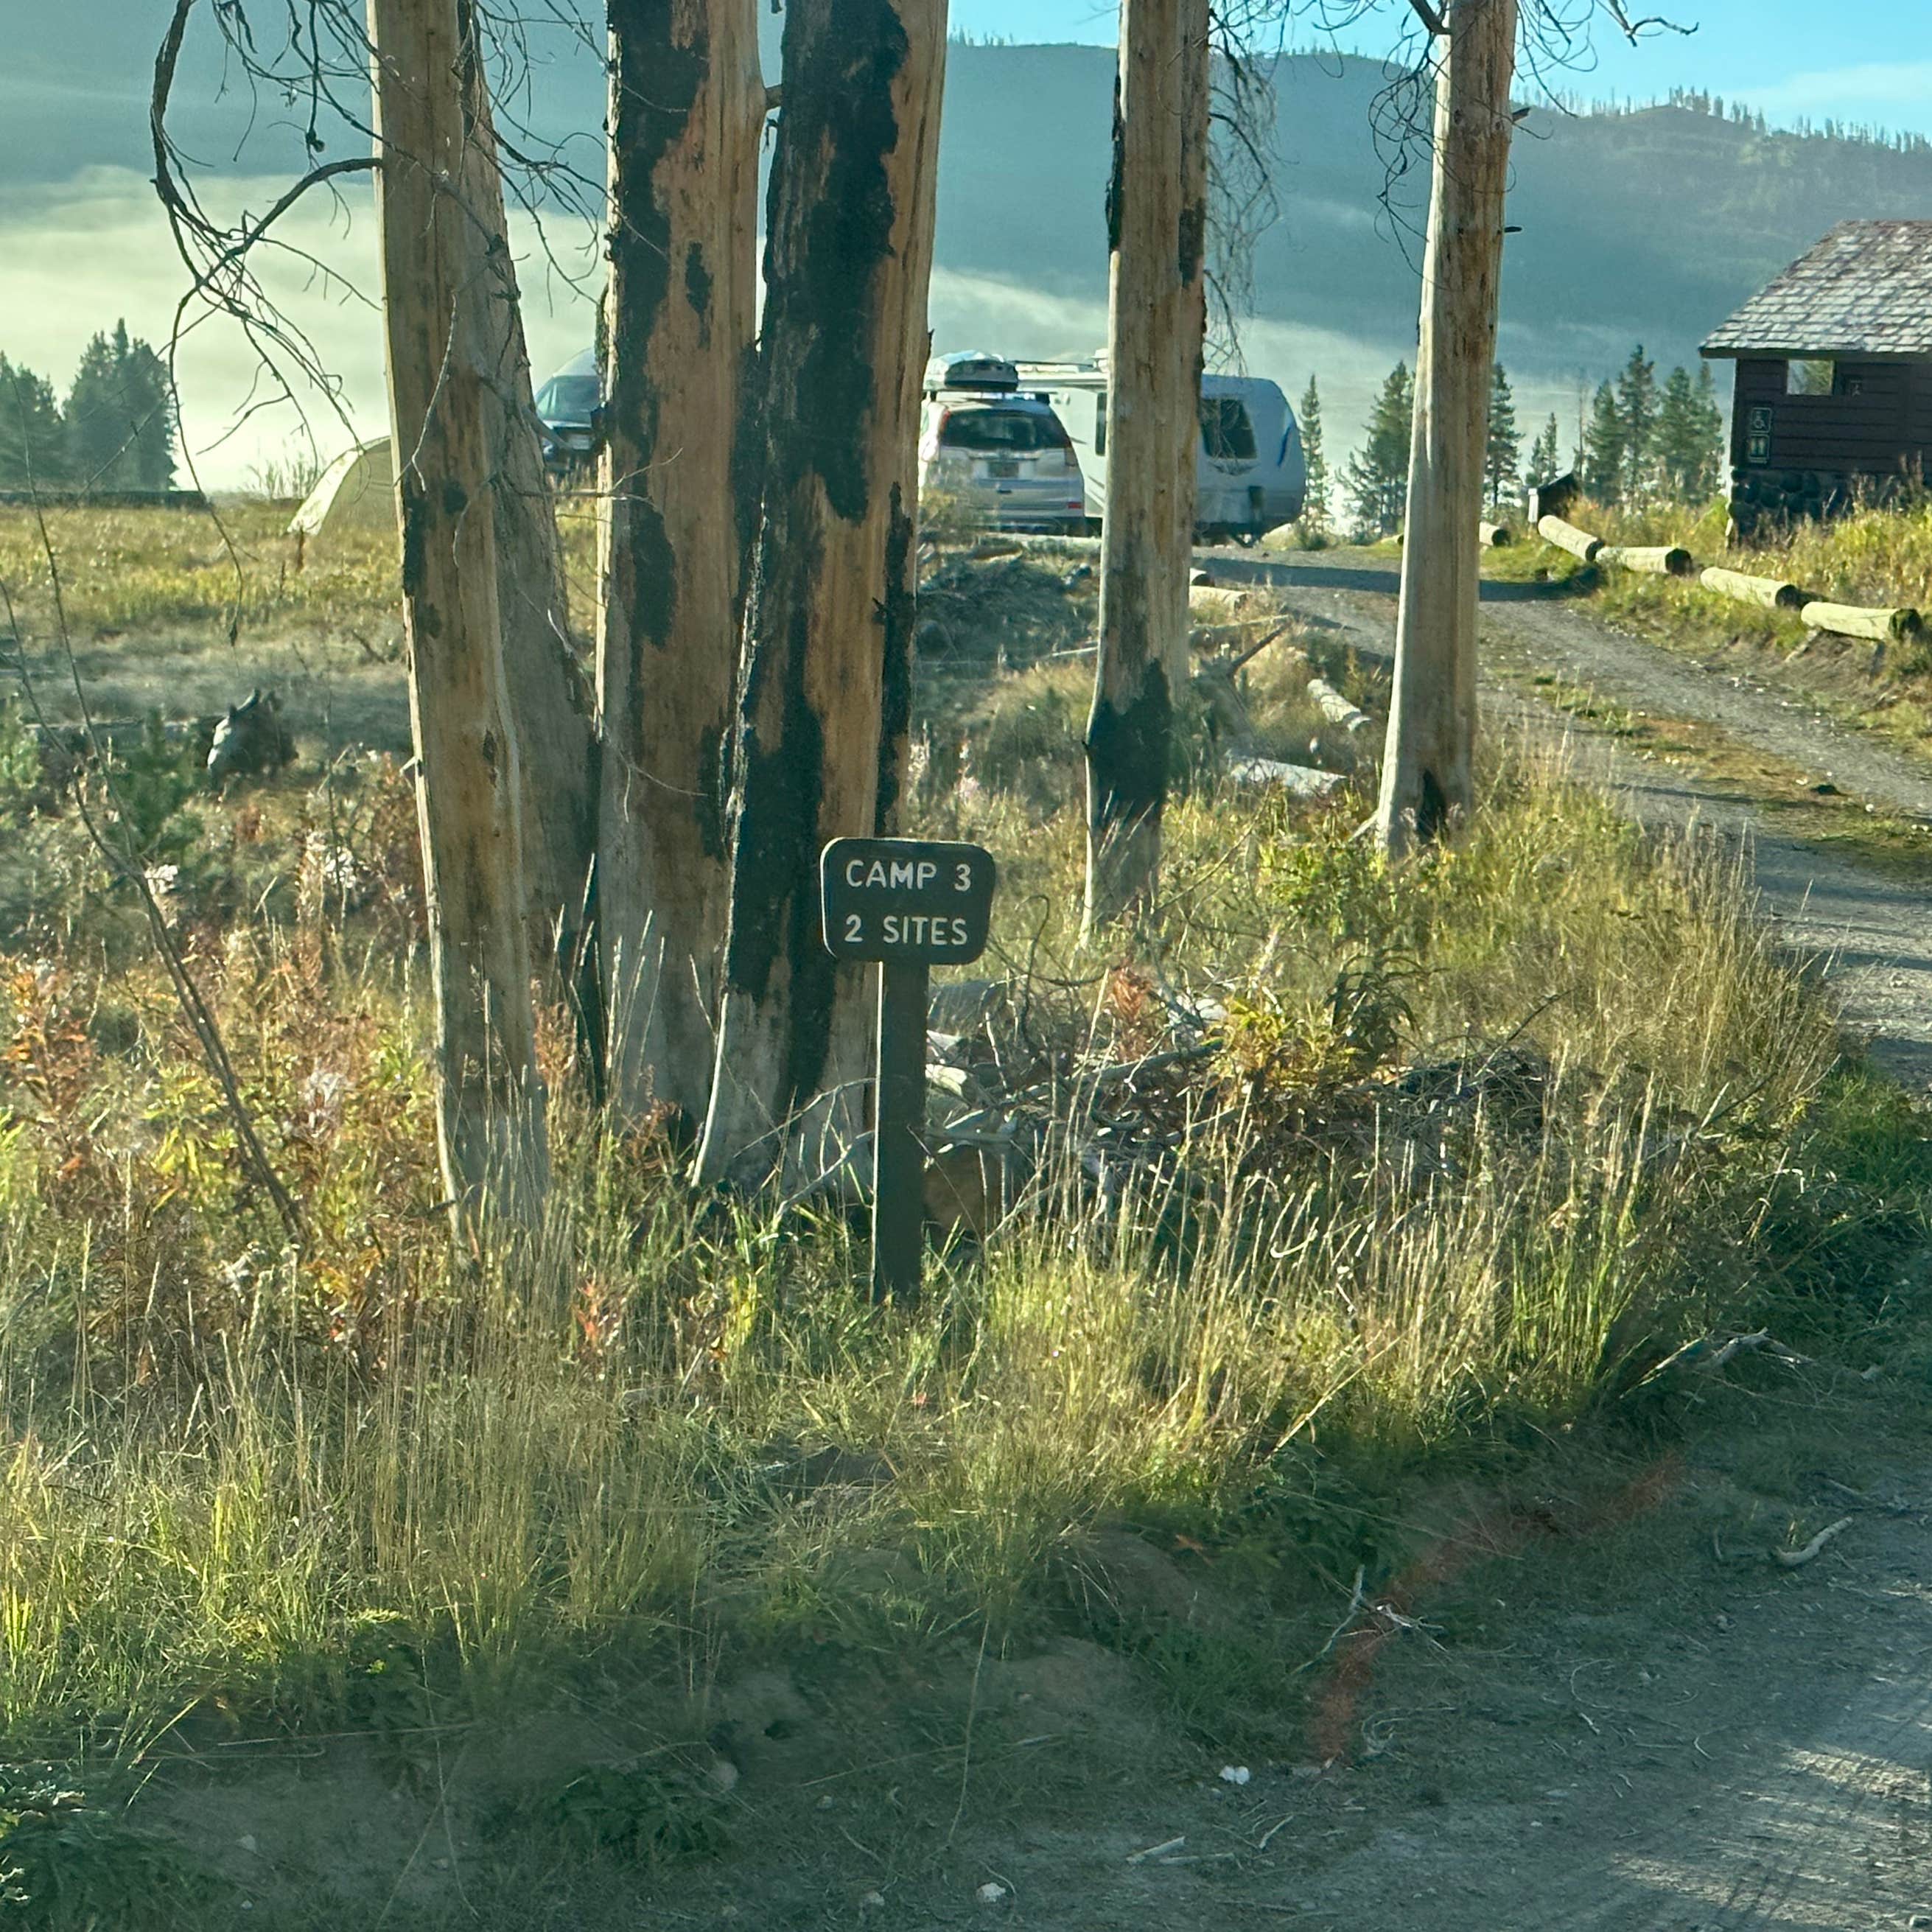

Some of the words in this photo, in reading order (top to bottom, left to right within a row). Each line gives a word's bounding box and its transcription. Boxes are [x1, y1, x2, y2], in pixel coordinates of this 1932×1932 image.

[845, 859, 937, 889] CAMP
[954, 863, 972, 892] 3
[844, 914, 864, 942] 2
[883, 915, 968, 945] SITES
